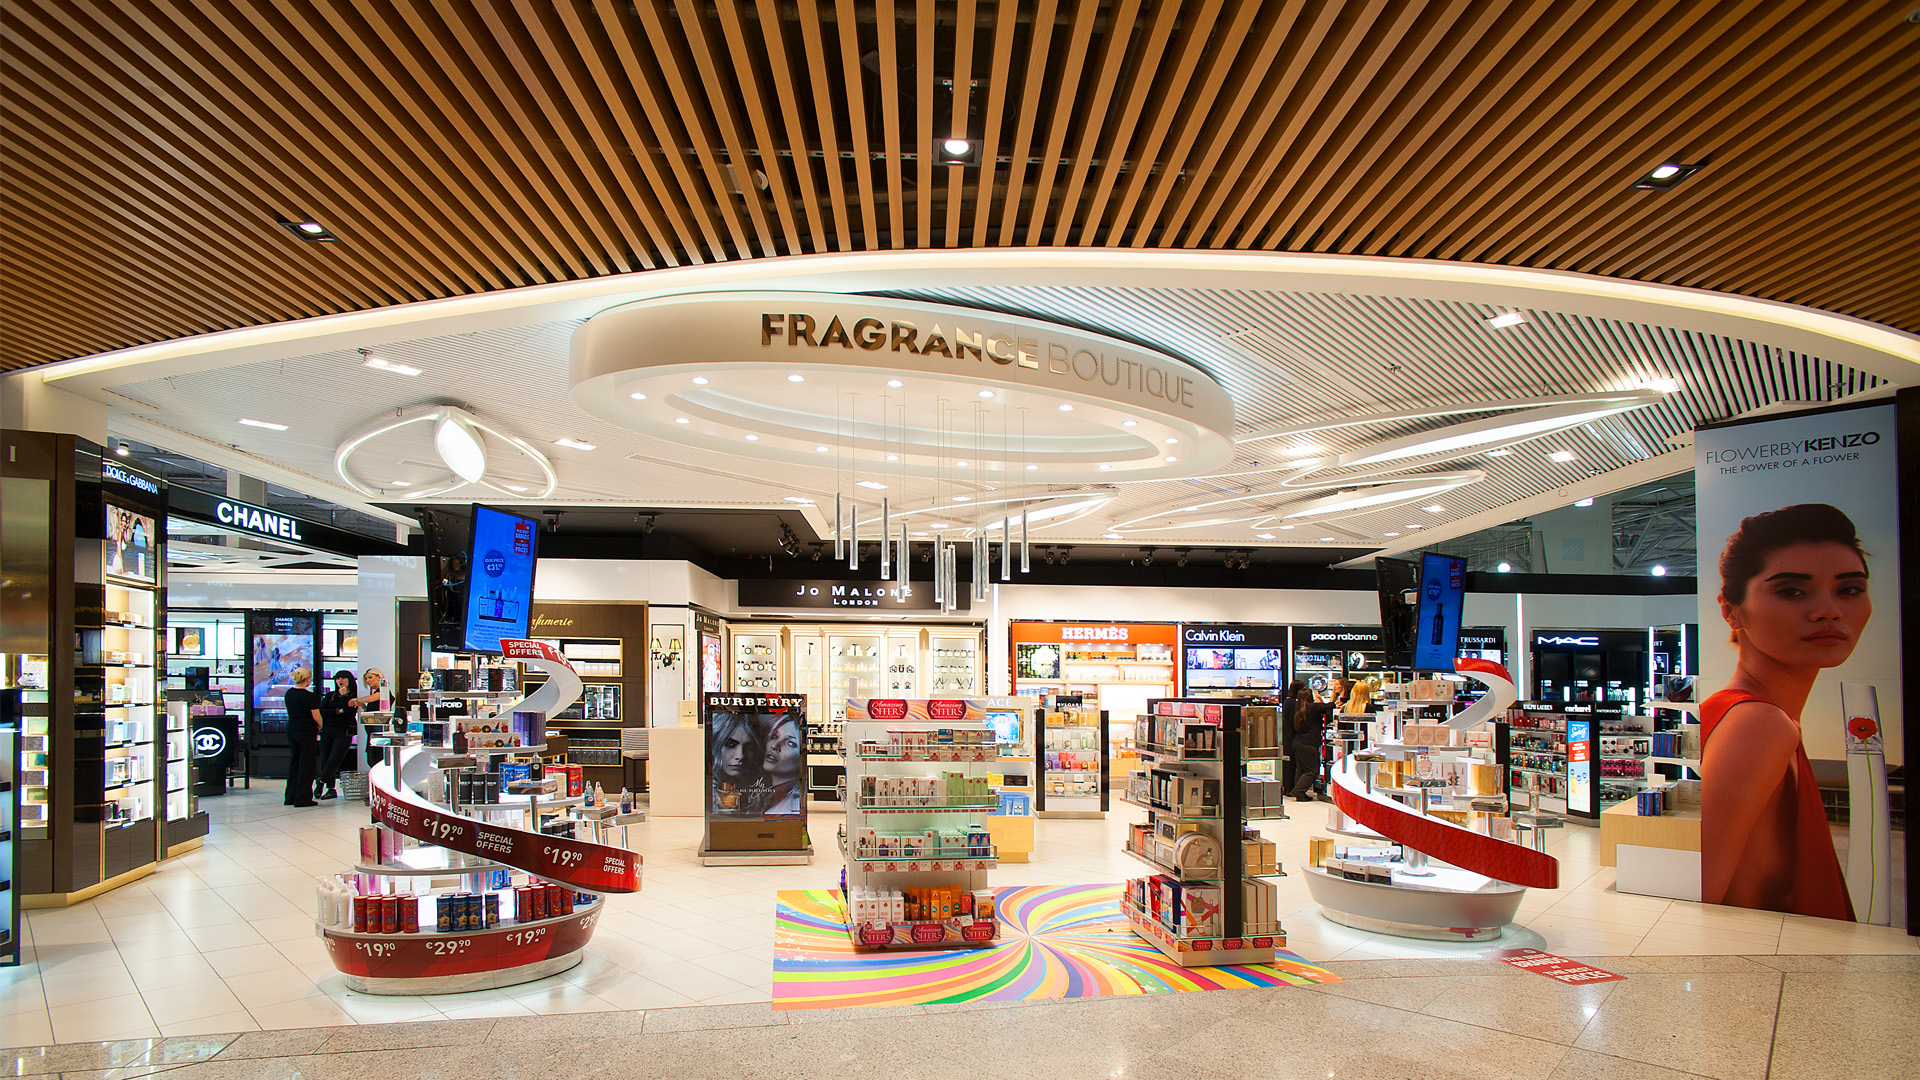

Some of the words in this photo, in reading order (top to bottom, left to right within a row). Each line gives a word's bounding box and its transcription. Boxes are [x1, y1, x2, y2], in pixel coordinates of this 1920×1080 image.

[761, 313, 1039, 370] FRAGRANCE
[1047, 341, 1194, 409] BOUTIQUE
[1719, 466, 1737, 475] THE
[1741, 462, 1779, 473] POWER
[1782, 459, 1797, 468] OF
[1801, 458, 1810, 466] A
[1813, 452, 1860, 465] FLOWER
[216, 501, 302, 541] CHANEL
[531, 613, 575, 630] rfumerie
[1185, 629, 1219, 641] Calvin
[1219, 630, 1245, 642] Klein
[1310, 633, 1337, 641] paco
[1337, 633, 1378, 641] rabanne
[1459, 636, 1496, 644] TRUSSARDI
[508, 641, 541, 649] SPECIAL
[509, 648, 542, 656] OFFERS
[709, 697, 803, 707] BURBERRY
[871, 707, 904, 716] OFFERS
[930, 707, 963, 716] OFFERS
[1565, 704, 1591, 713] cacharel
[387, 802, 410, 818] SPECIAL
[386, 812, 409, 826] OFFERS
[477, 831, 514, 845] SPECIAL
[476, 840, 512, 854] OFFERS
[604, 856, 626, 867] SPECIAL
[603, 864, 625, 875] OFFERS
[862, 934, 891, 942] OFFERS
[914, 932, 943, 940] OFFERS
[965, 930, 993, 938] OFFERS
[1554, 970, 1613, 982] PRICES
